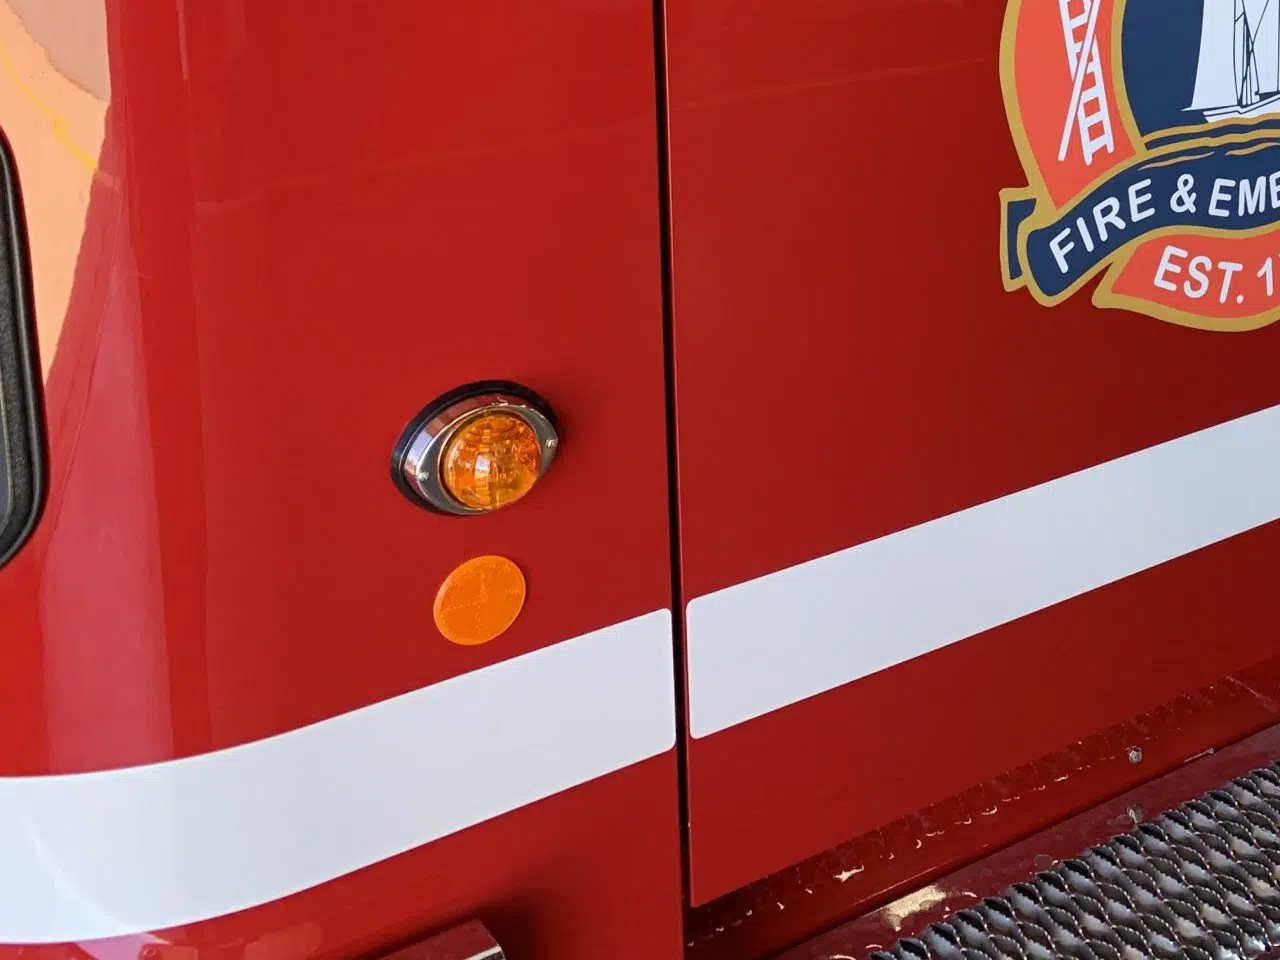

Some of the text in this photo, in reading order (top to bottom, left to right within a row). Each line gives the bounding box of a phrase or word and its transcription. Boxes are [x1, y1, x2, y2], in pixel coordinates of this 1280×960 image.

[1048, 178, 1155, 275] FIRE
[1170, 173, 1197, 214] &
[1154, 245, 1245, 305] EST.
